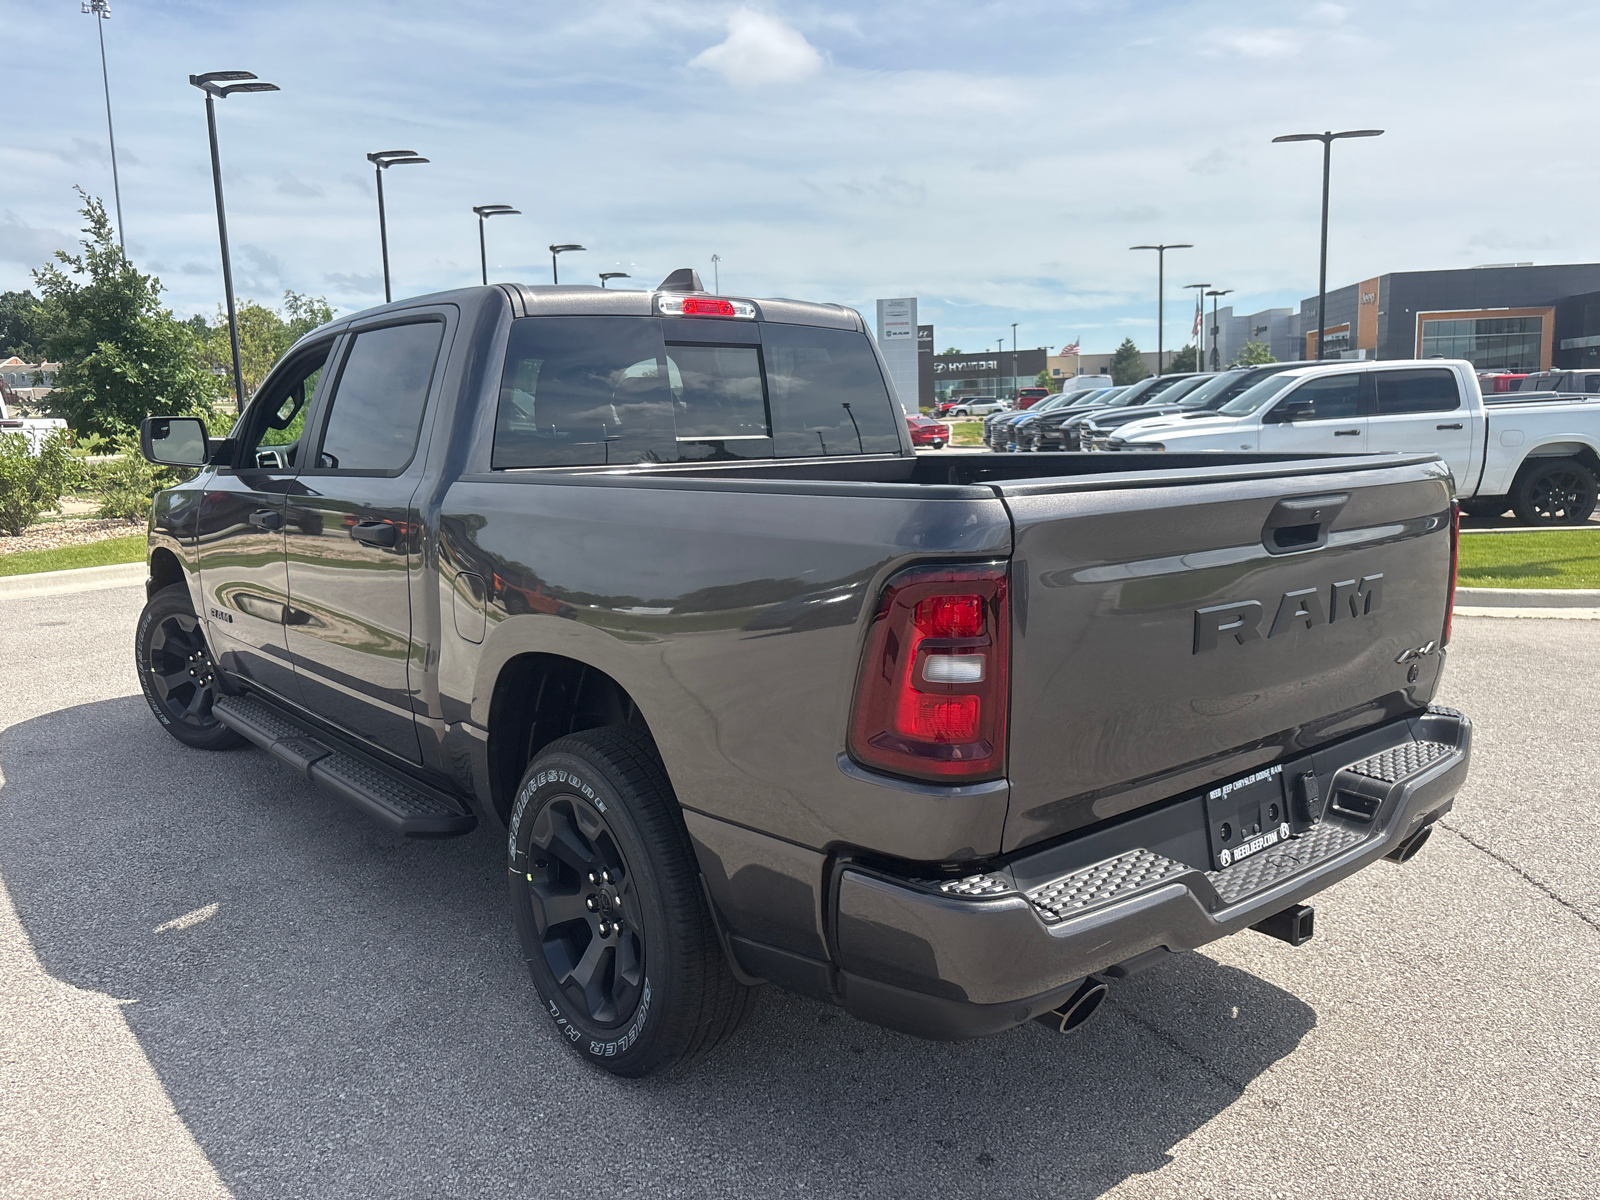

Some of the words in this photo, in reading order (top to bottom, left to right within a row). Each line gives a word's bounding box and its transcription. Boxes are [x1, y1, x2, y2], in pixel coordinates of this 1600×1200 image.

[1360, 292, 1377, 305] Jeep
[948, 360, 998, 372] HYUNDAI
[1192, 572, 1384, 655] RAM
[1209, 787, 1222, 800] REED
[1222, 783, 1233, 794] JEEP
[1232, 774, 1256, 791] CHRYSLER
[1255, 768, 1271, 781] DODGE
[1270, 763, 1283, 776] RAM
[508, 769, 608, 862] BRIDGESTONE
[1233, 831, 1279, 861] REEDJEEP.COM
[549, 999, 581, 1042] H/L
[589, 976, 652, 1057] DUELER
